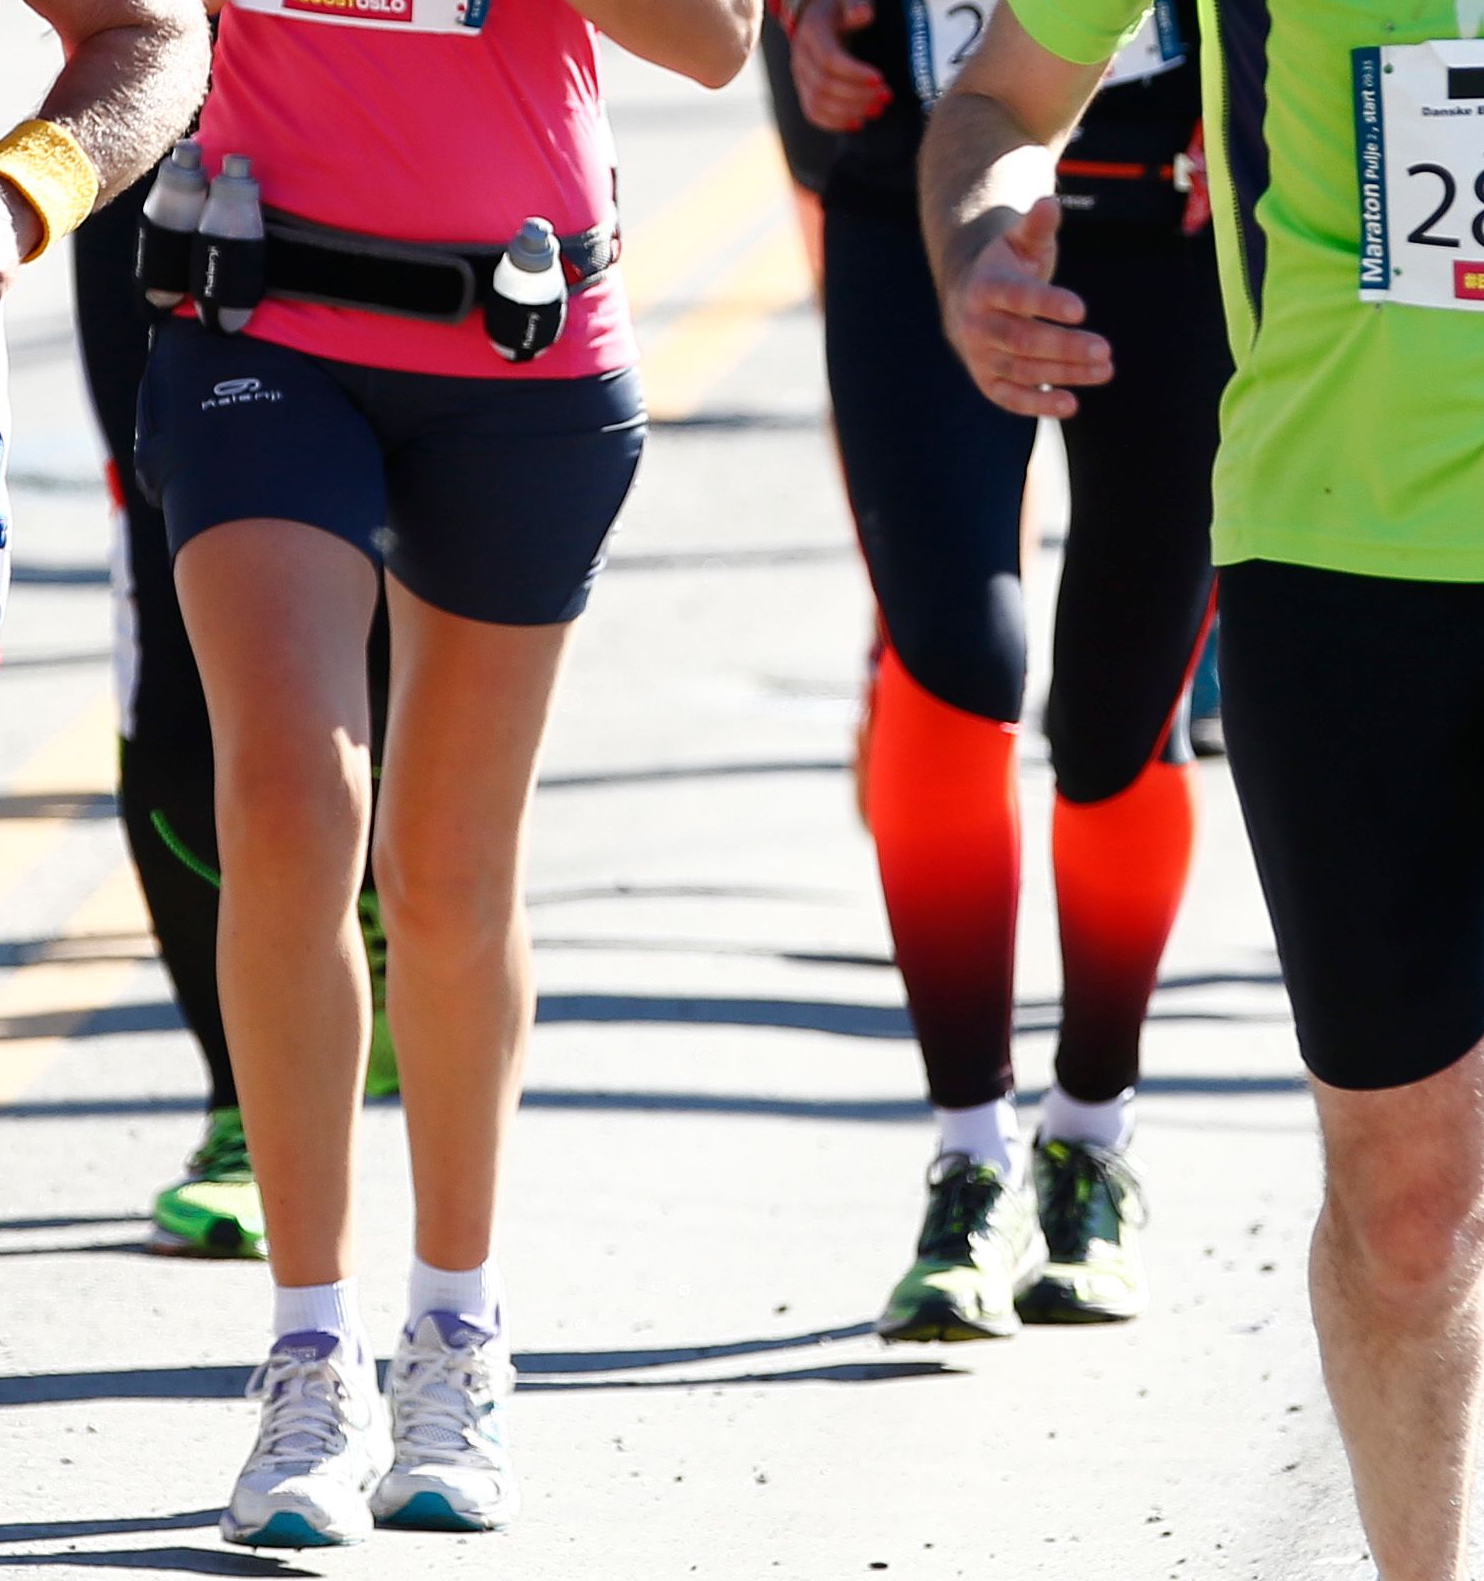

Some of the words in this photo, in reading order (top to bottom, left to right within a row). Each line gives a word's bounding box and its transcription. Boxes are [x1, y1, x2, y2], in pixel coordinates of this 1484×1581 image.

[1361, 90, 1377, 124] start
[1422, 106, 1472, 117] Danske
[1363, 142, 1381, 179] Pulje
[1362, 183, 1383, 282] Maraton
